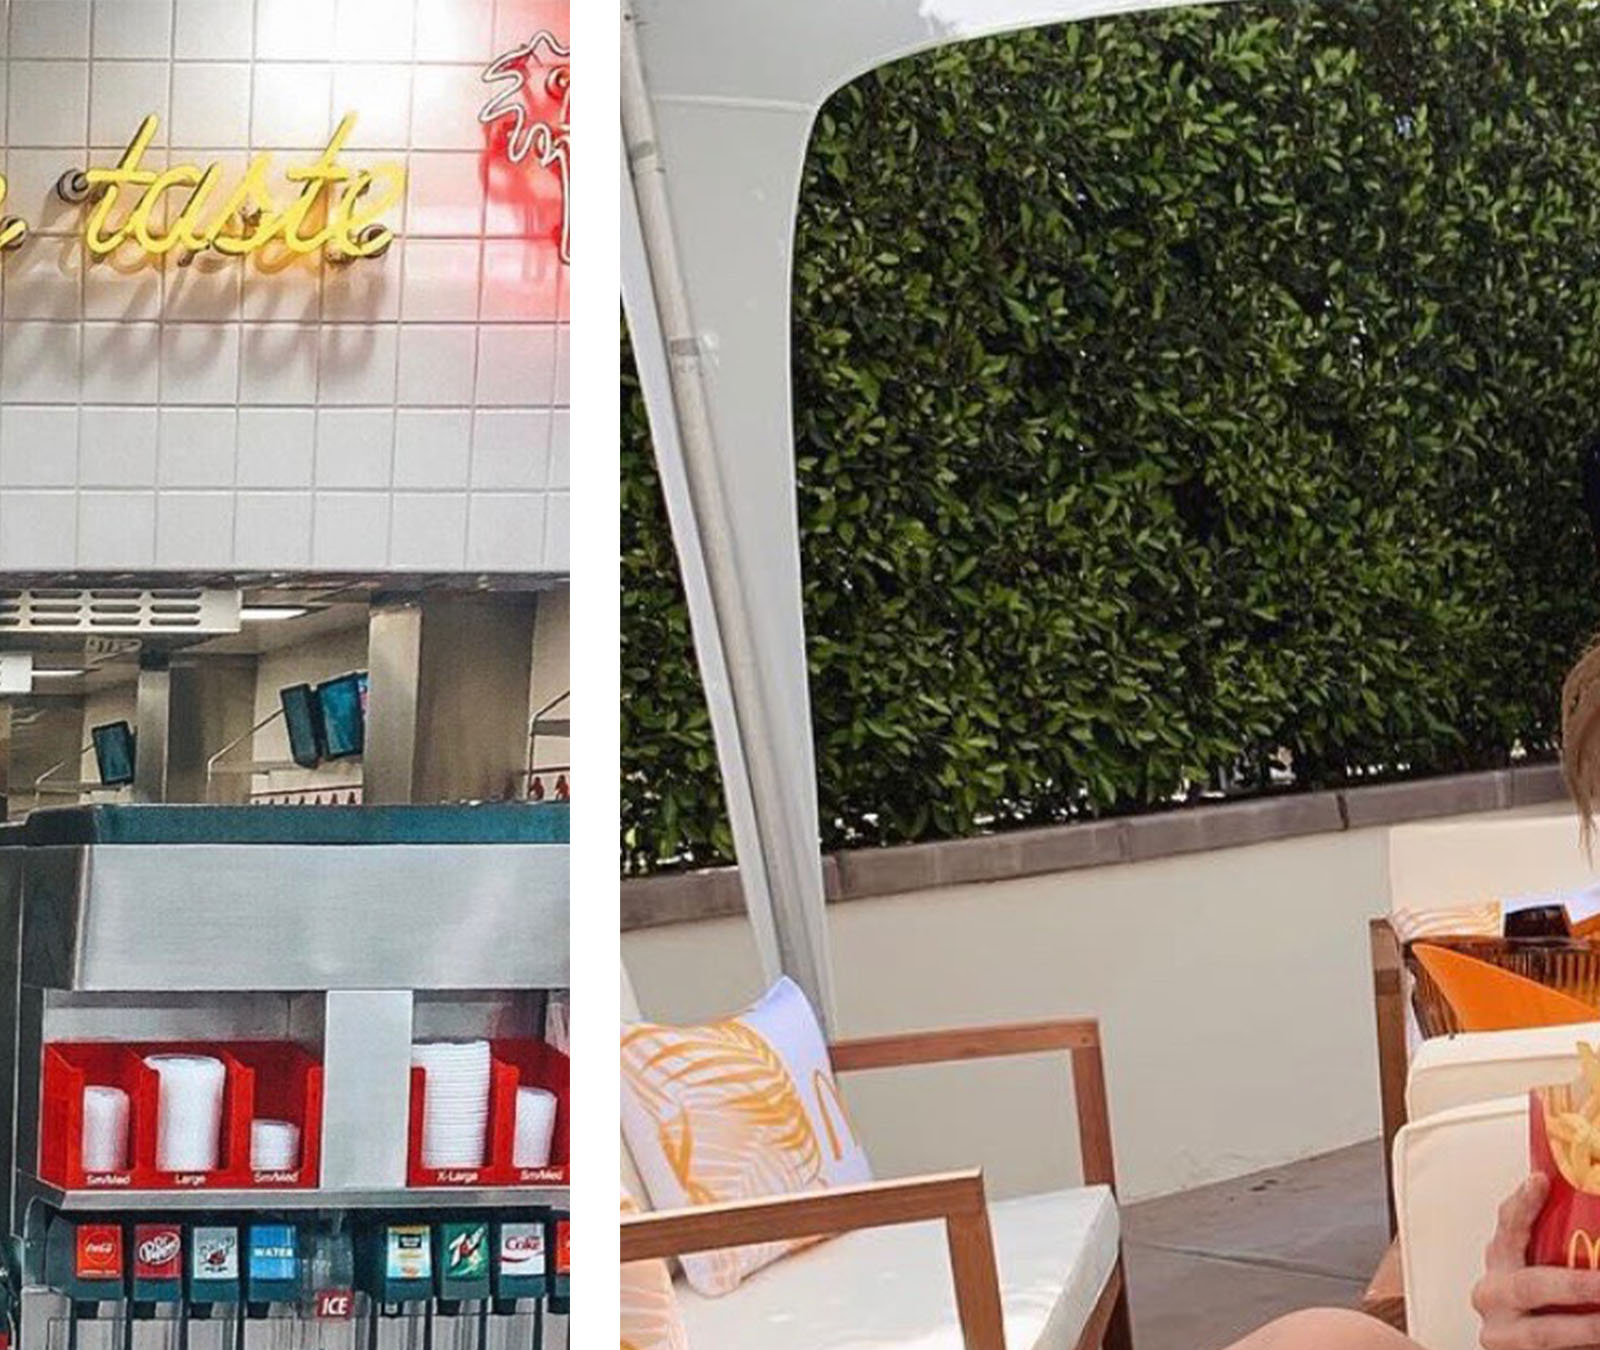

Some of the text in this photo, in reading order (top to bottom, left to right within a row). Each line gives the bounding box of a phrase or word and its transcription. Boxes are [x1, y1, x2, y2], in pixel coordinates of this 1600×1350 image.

[84, 111, 401, 258] taste
[174, 1173, 207, 1186] Large
[253, 1247, 294, 1258] WATER
[321, 1297, 349, 1316] ICE
